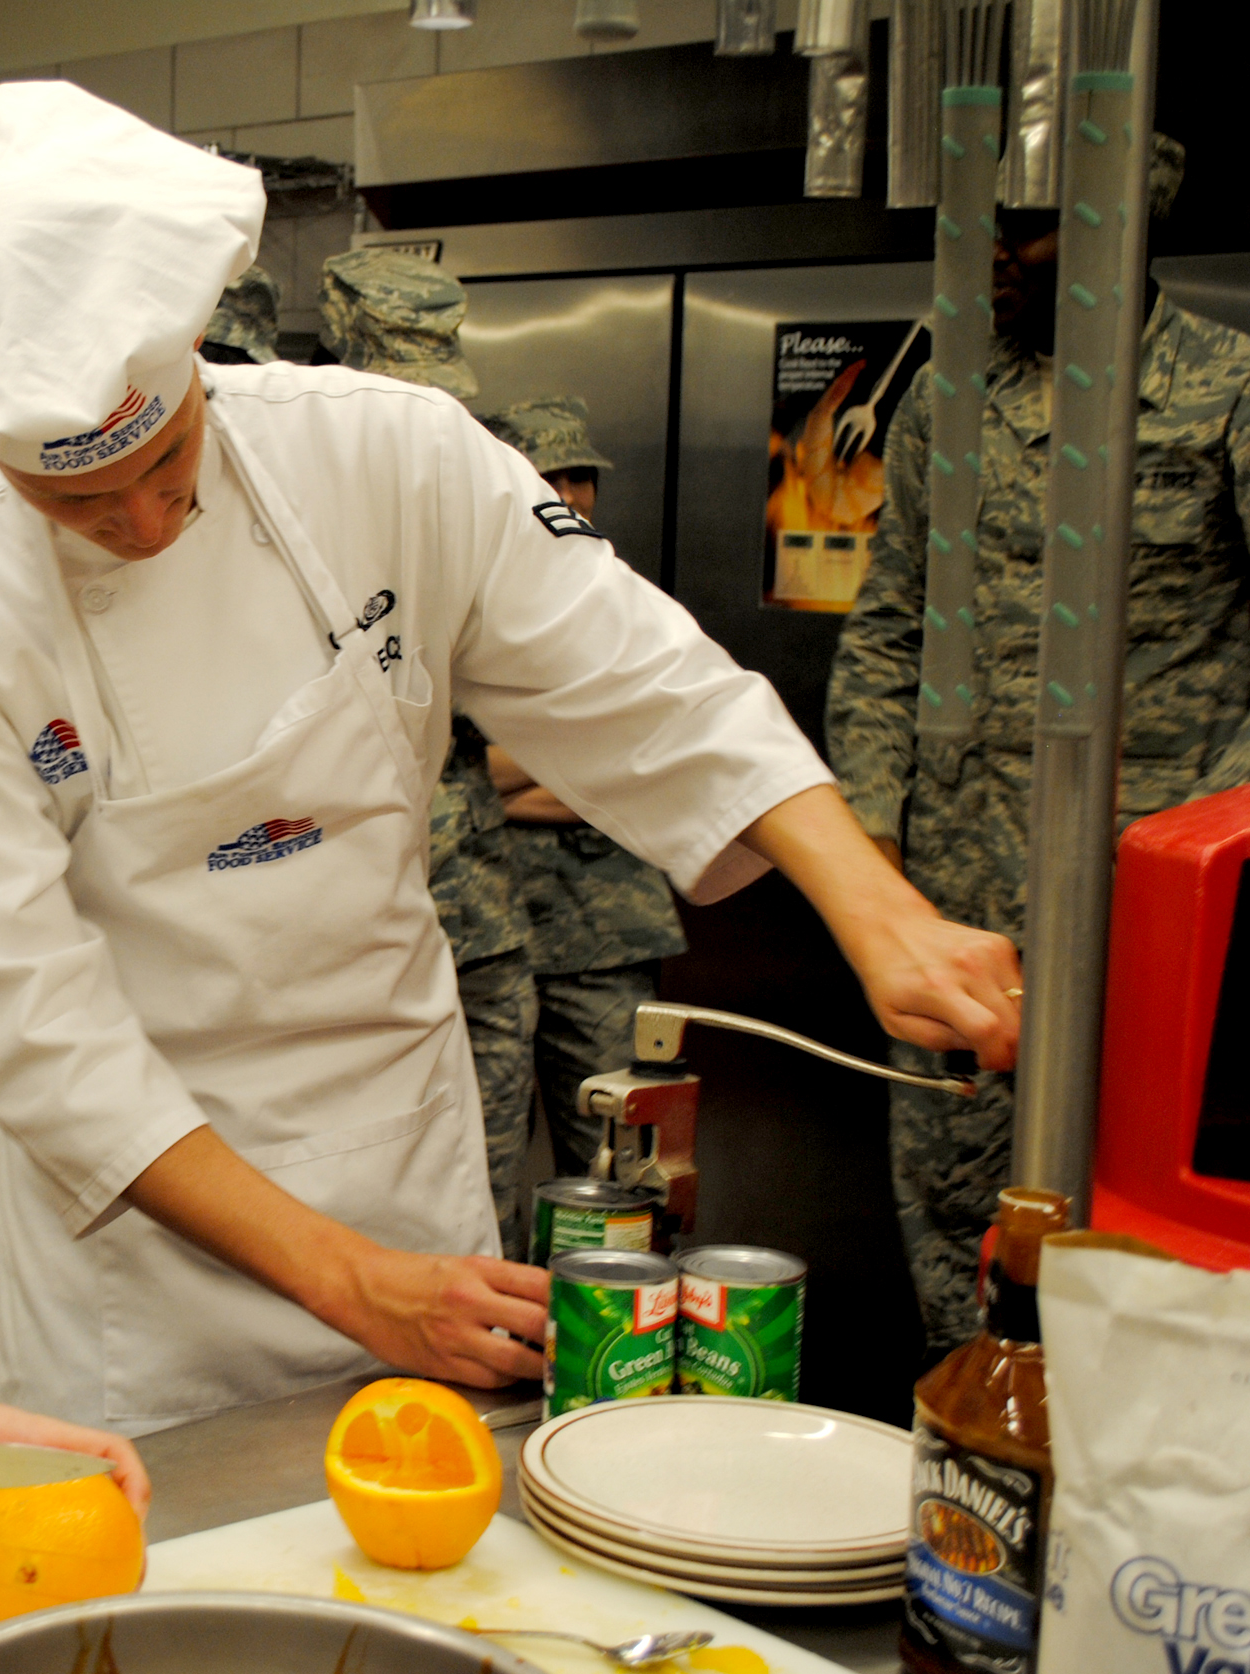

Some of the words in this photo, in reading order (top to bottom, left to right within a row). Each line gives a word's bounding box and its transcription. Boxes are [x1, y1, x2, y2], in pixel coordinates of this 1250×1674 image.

[40, 451, 62, 462] AIR
[63, 439, 108, 458] FORCE
[43, 454, 94, 471] FOOD
[97, 405, 166, 460] SERVICE
[208, 857, 252, 872] FOOD
[255, 836, 323, 864] SERVICE
[608, 1349, 664, 1381] Green
[686, 1336, 742, 1377] Beans
[943, 1457, 1032, 1549] DANIEL'S
